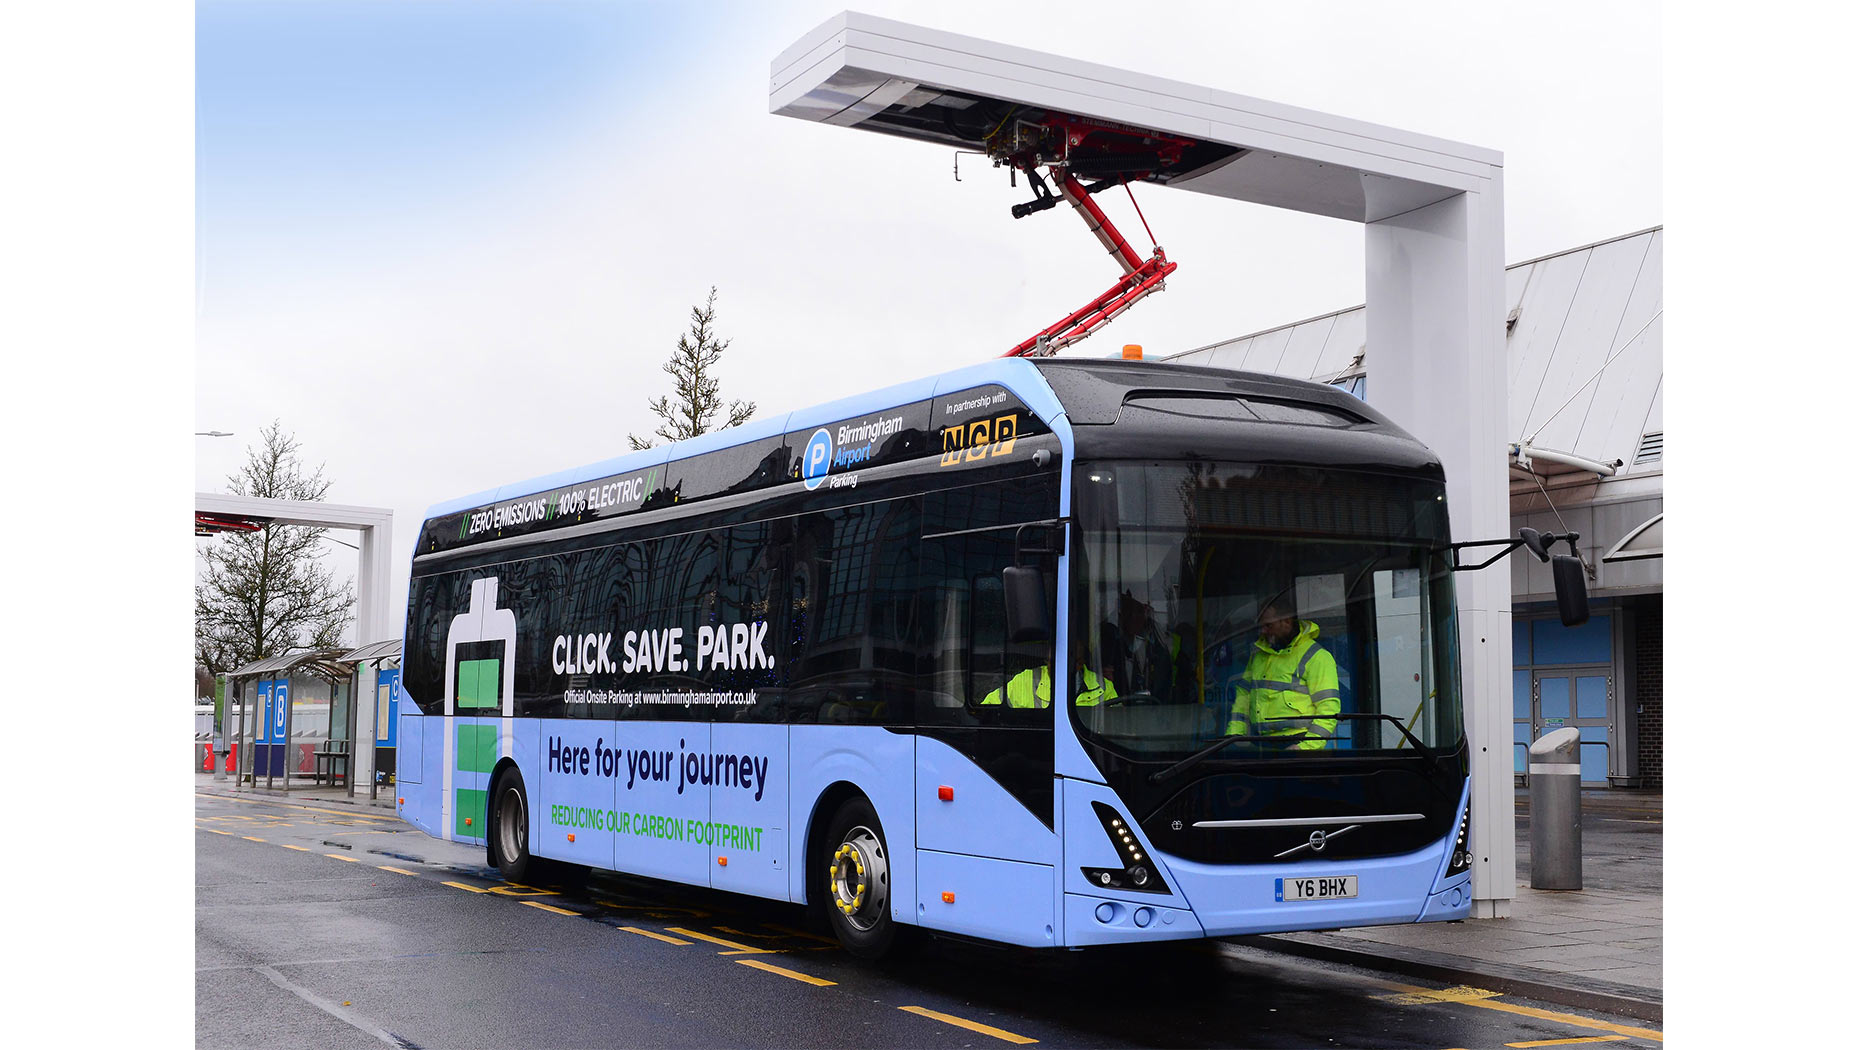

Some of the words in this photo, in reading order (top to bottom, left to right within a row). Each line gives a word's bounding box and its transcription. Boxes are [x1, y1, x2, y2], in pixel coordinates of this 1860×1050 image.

[946, 403, 953, 414] In
[953, 395, 991, 415] partnership
[992, 391, 1007, 404] with
[837, 416, 903, 445] Birmingham
[941, 414, 1017, 467] NCP
[809, 442, 826, 477] P
[833, 441, 872, 469] Airport
[829, 474, 858, 489] Parking
[469, 511, 493, 534] ZERO
[493, 498, 547, 528] EMISSIONS
[559, 489, 587, 515] 100%
[587, 477, 643, 510] ELECTRIC
[552, 632, 617, 675] CLICK.
[622, 627, 689, 674] SAVE.
[697, 620, 775, 672] PARK.
[277, 695, 285, 727] B
[563, 689, 586, 704] Official
[586, 689, 608, 704] Onsite
[608, 690, 633, 707] Parking
[634, 690, 642, 704] at
[643, 689, 757, 708] www.birminghamairport.co.uk
[548, 736, 590, 776] Here
[595, 737, 622, 777] for
[627, 749, 673, 790] your
[677, 738, 768, 802] journey
[551, 804, 604, 831] REDUCING
[606, 810, 630, 834] OUR
[633, 814, 683, 842] CARBON
[687, 820, 763, 852] FOOTPRINT
[1295, 880, 1315, 897] Y6
[1319, 878, 1347, 896] BHX
